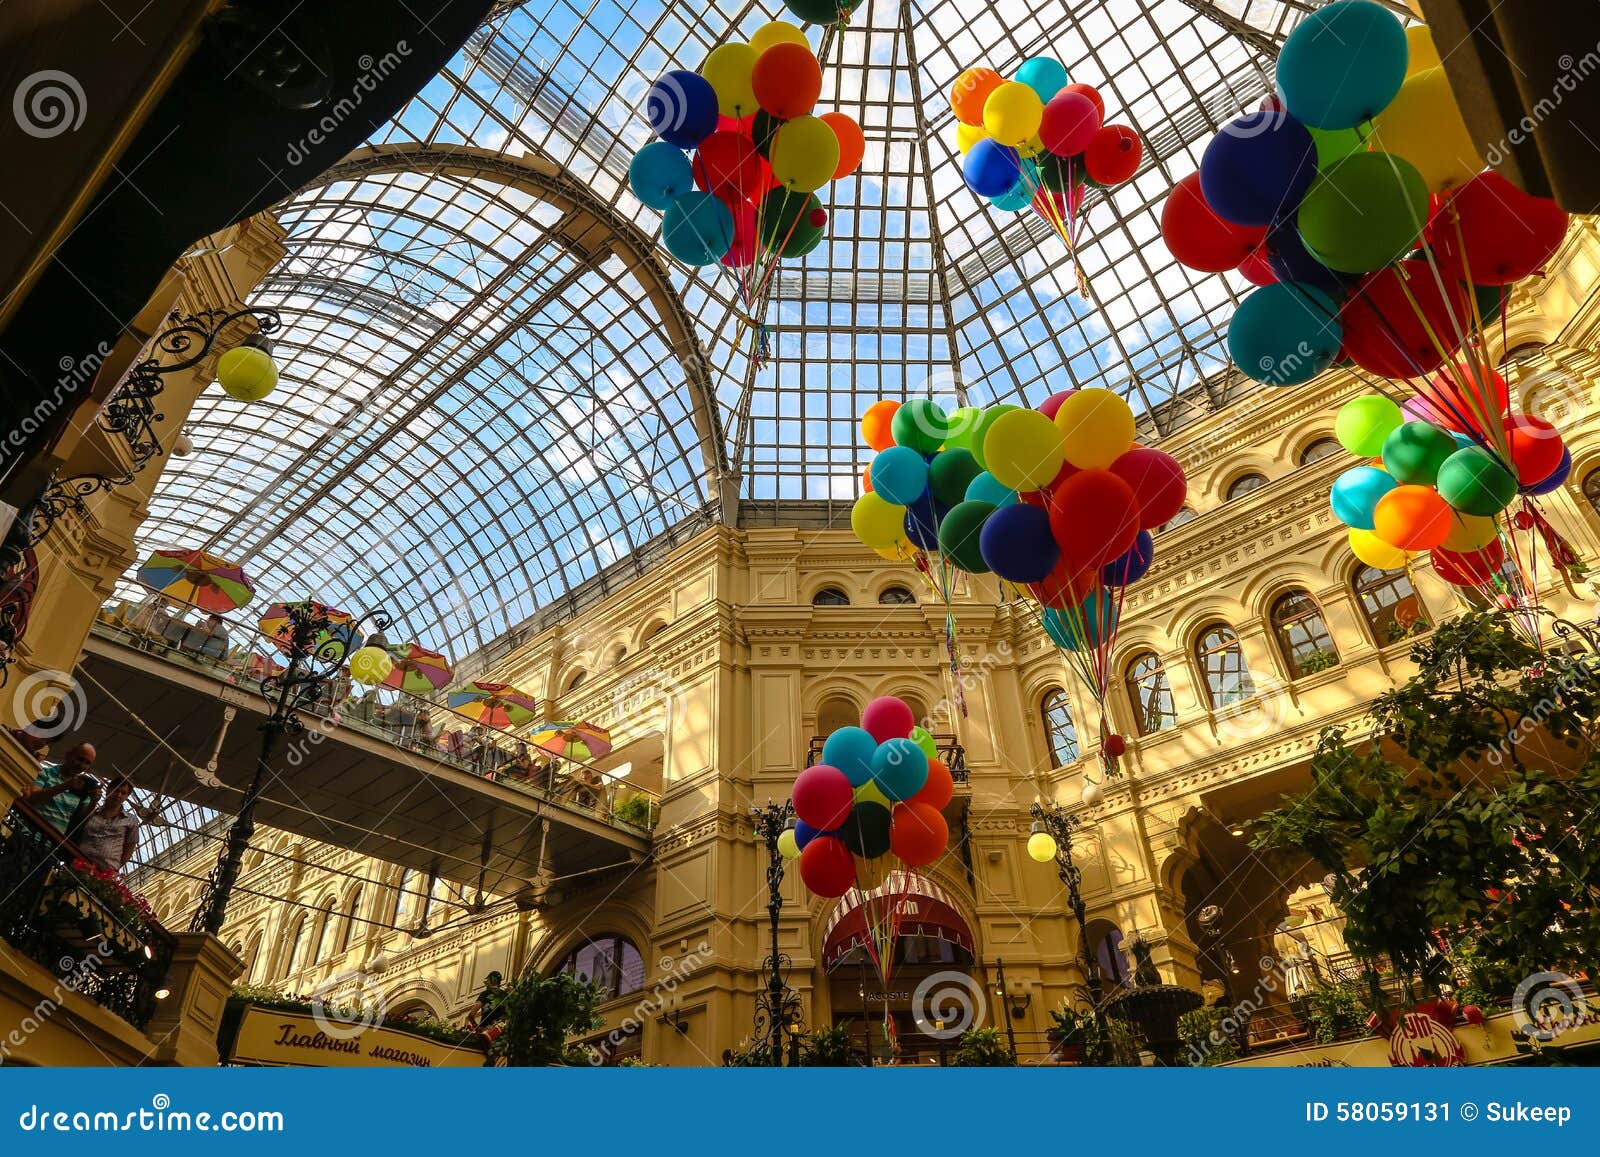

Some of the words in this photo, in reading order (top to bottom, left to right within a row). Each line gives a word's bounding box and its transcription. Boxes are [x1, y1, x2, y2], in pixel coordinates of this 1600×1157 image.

[862, 991, 909, 1001] ACOSTE
[274, 1024, 361, 1054] Главный
[369, 1045, 431, 1067] магазин
